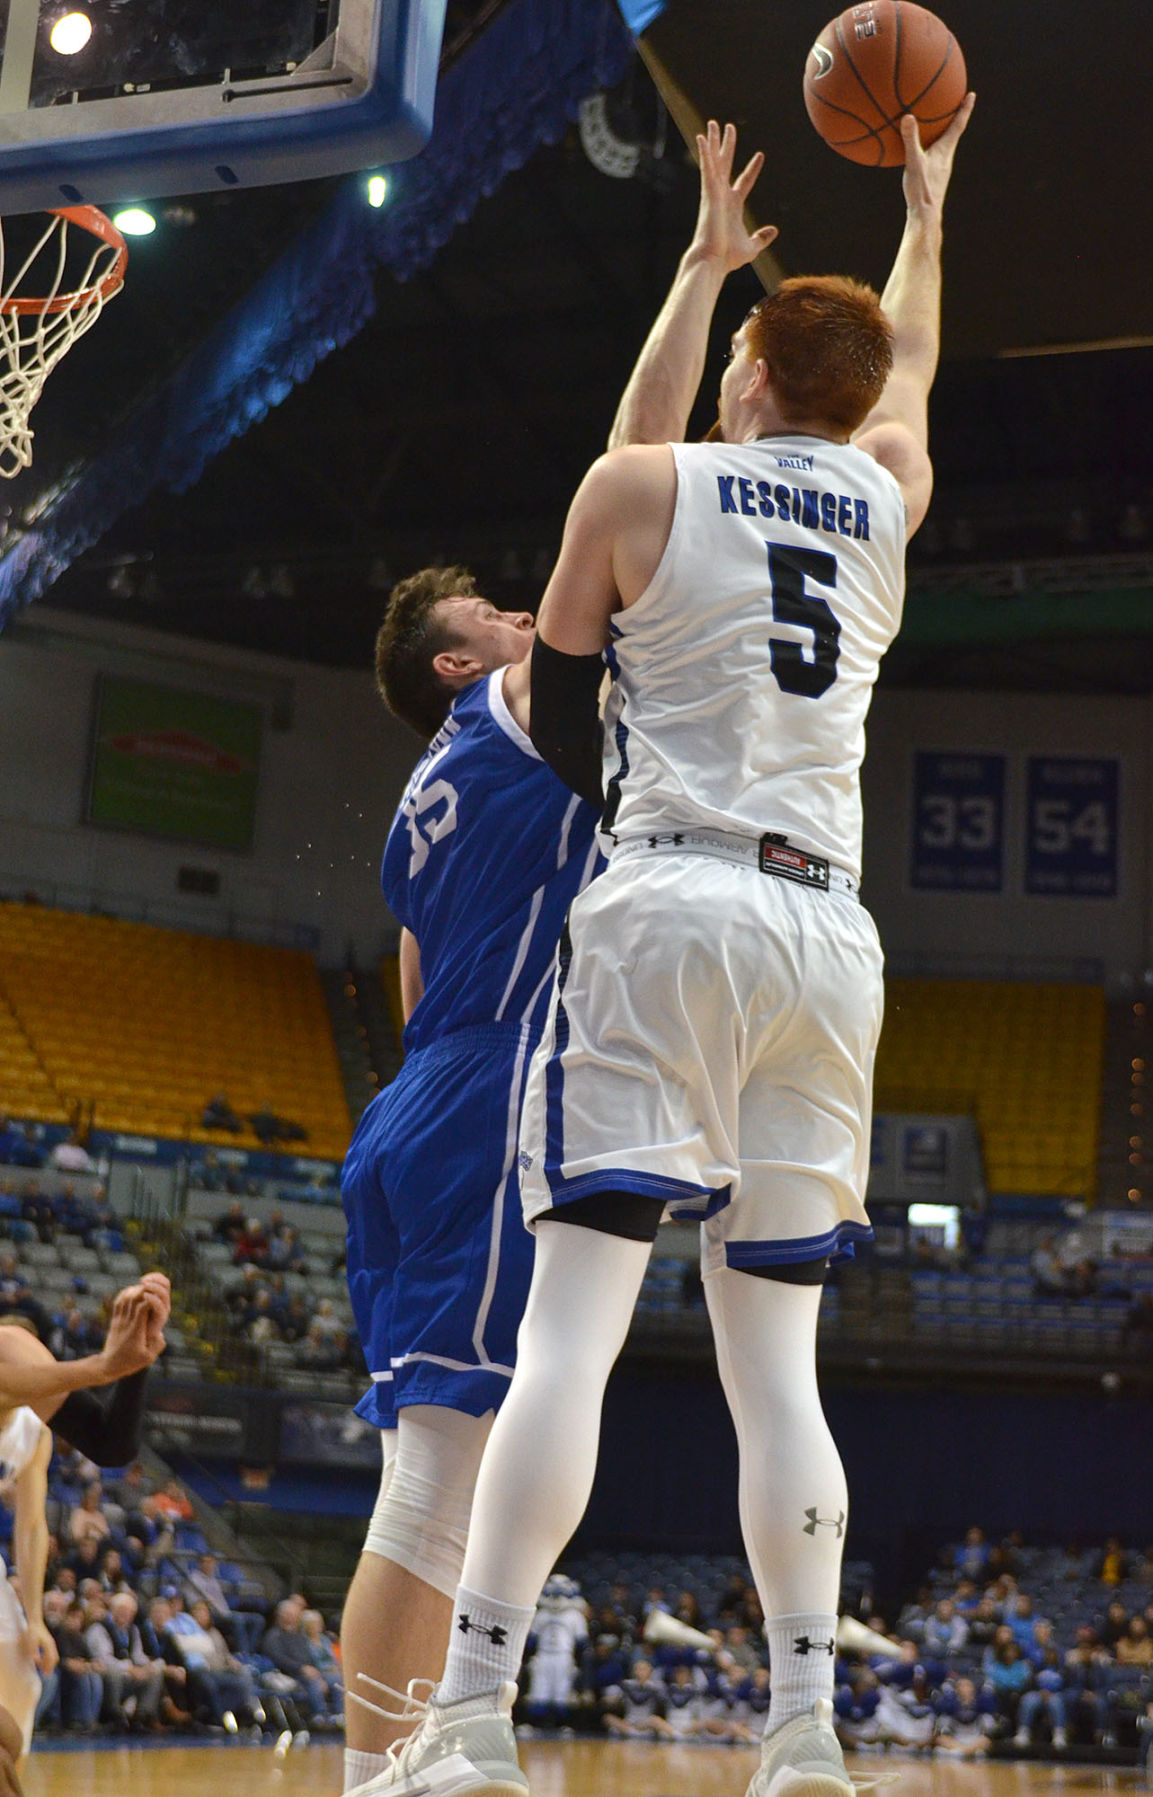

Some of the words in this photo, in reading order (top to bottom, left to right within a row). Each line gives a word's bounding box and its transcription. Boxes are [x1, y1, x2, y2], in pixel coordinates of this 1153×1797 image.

[774, 455, 814, 472] VALLEY
[717, 475, 870, 541] KESSINGER
[765, 540, 842, 699] 5
[922, 797, 995, 850] 33
[1036, 802, 1106, 856] 54
